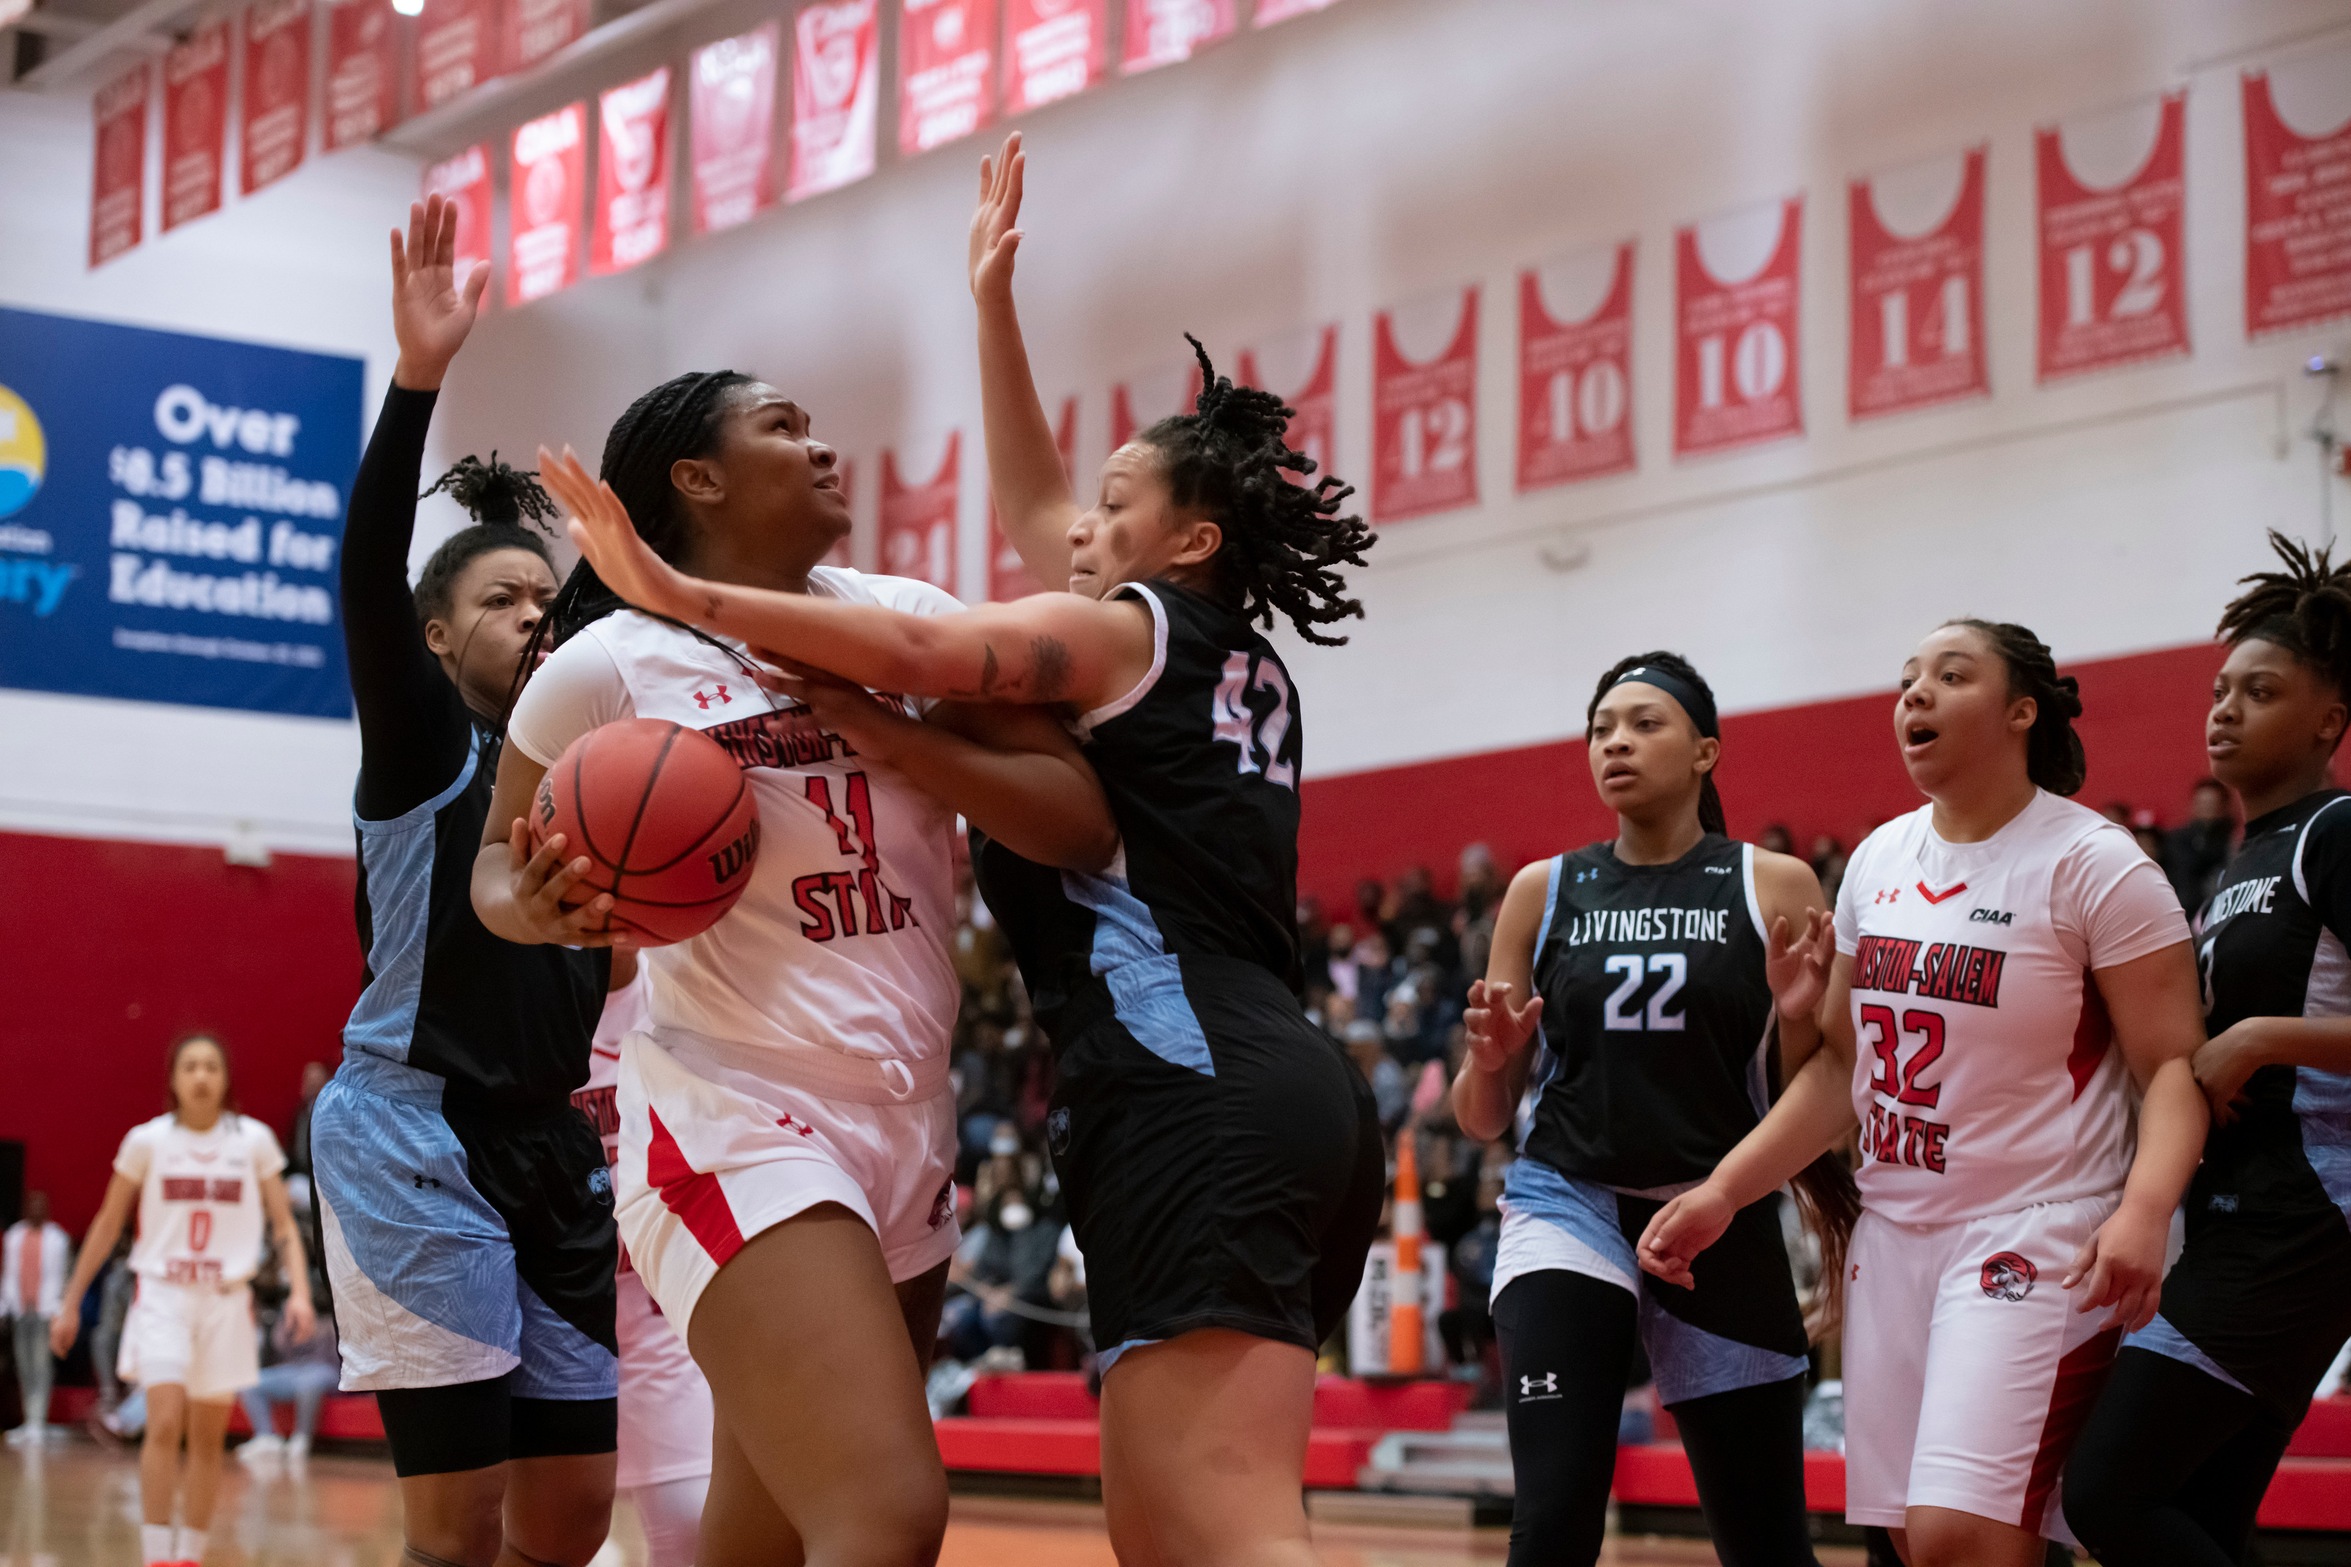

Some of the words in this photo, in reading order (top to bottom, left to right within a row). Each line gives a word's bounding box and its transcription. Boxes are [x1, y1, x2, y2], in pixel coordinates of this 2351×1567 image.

[2065, 227, 2166, 327] 12
[1699, 322, 1787, 408] 10
[154, 383, 301, 457] Over
[200, 455, 340, 520] Billion
[110, 498, 262, 564] Raised
[268, 520, 336, 573] for
[109, 552, 334, 625] Education
[1211, 650, 1295, 793] 42
[1569, 907, 1729, 947] LIVINGSTONE
[1969, 908, 2012, 927] CIAA
[1603, 952, 1688, 1031] 22
[1861, 1003, 1946, 1110] 32
[189, 1210, 213, 1252] 0
